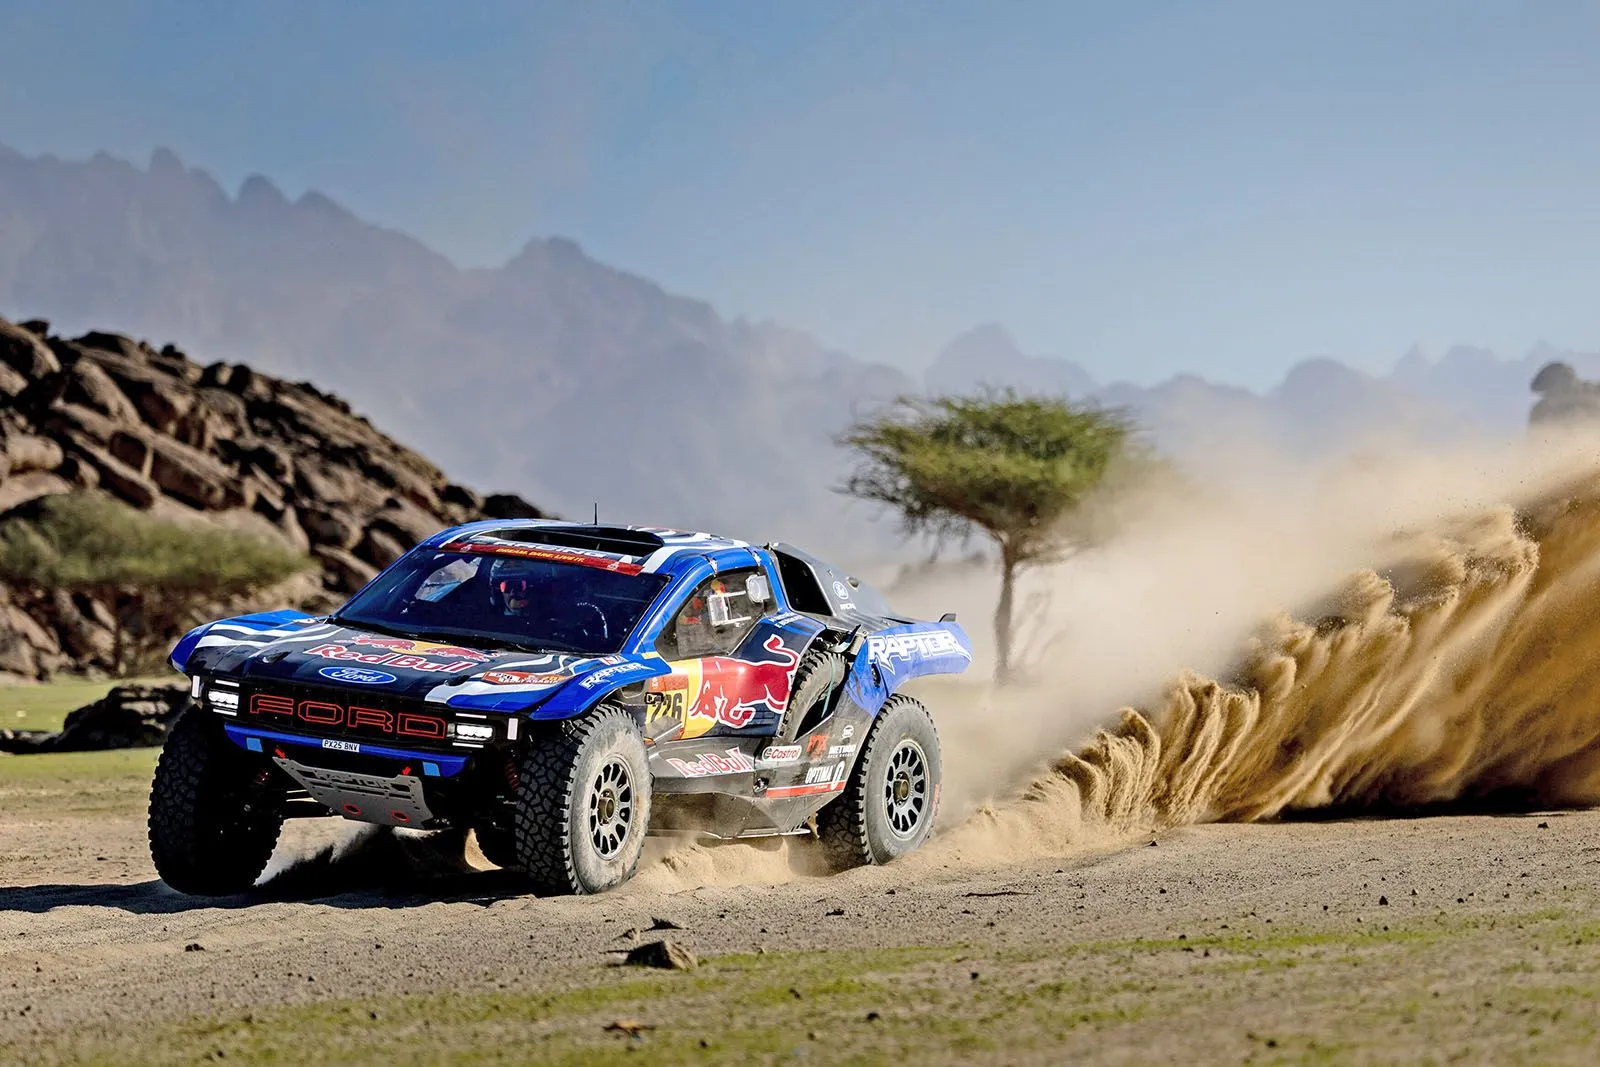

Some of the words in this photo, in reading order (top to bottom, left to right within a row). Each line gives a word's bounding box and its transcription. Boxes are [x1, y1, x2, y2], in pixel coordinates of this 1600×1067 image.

[329, 667, 383, 683] Ford
[249, 693, 446, 740] FORD
[323, 739, 343, 749] PX25
[344, 742, 359, 752] BNV
[771, 747, 800, 760] Castrol
[804, 764, 836, 785] OPTIMA
